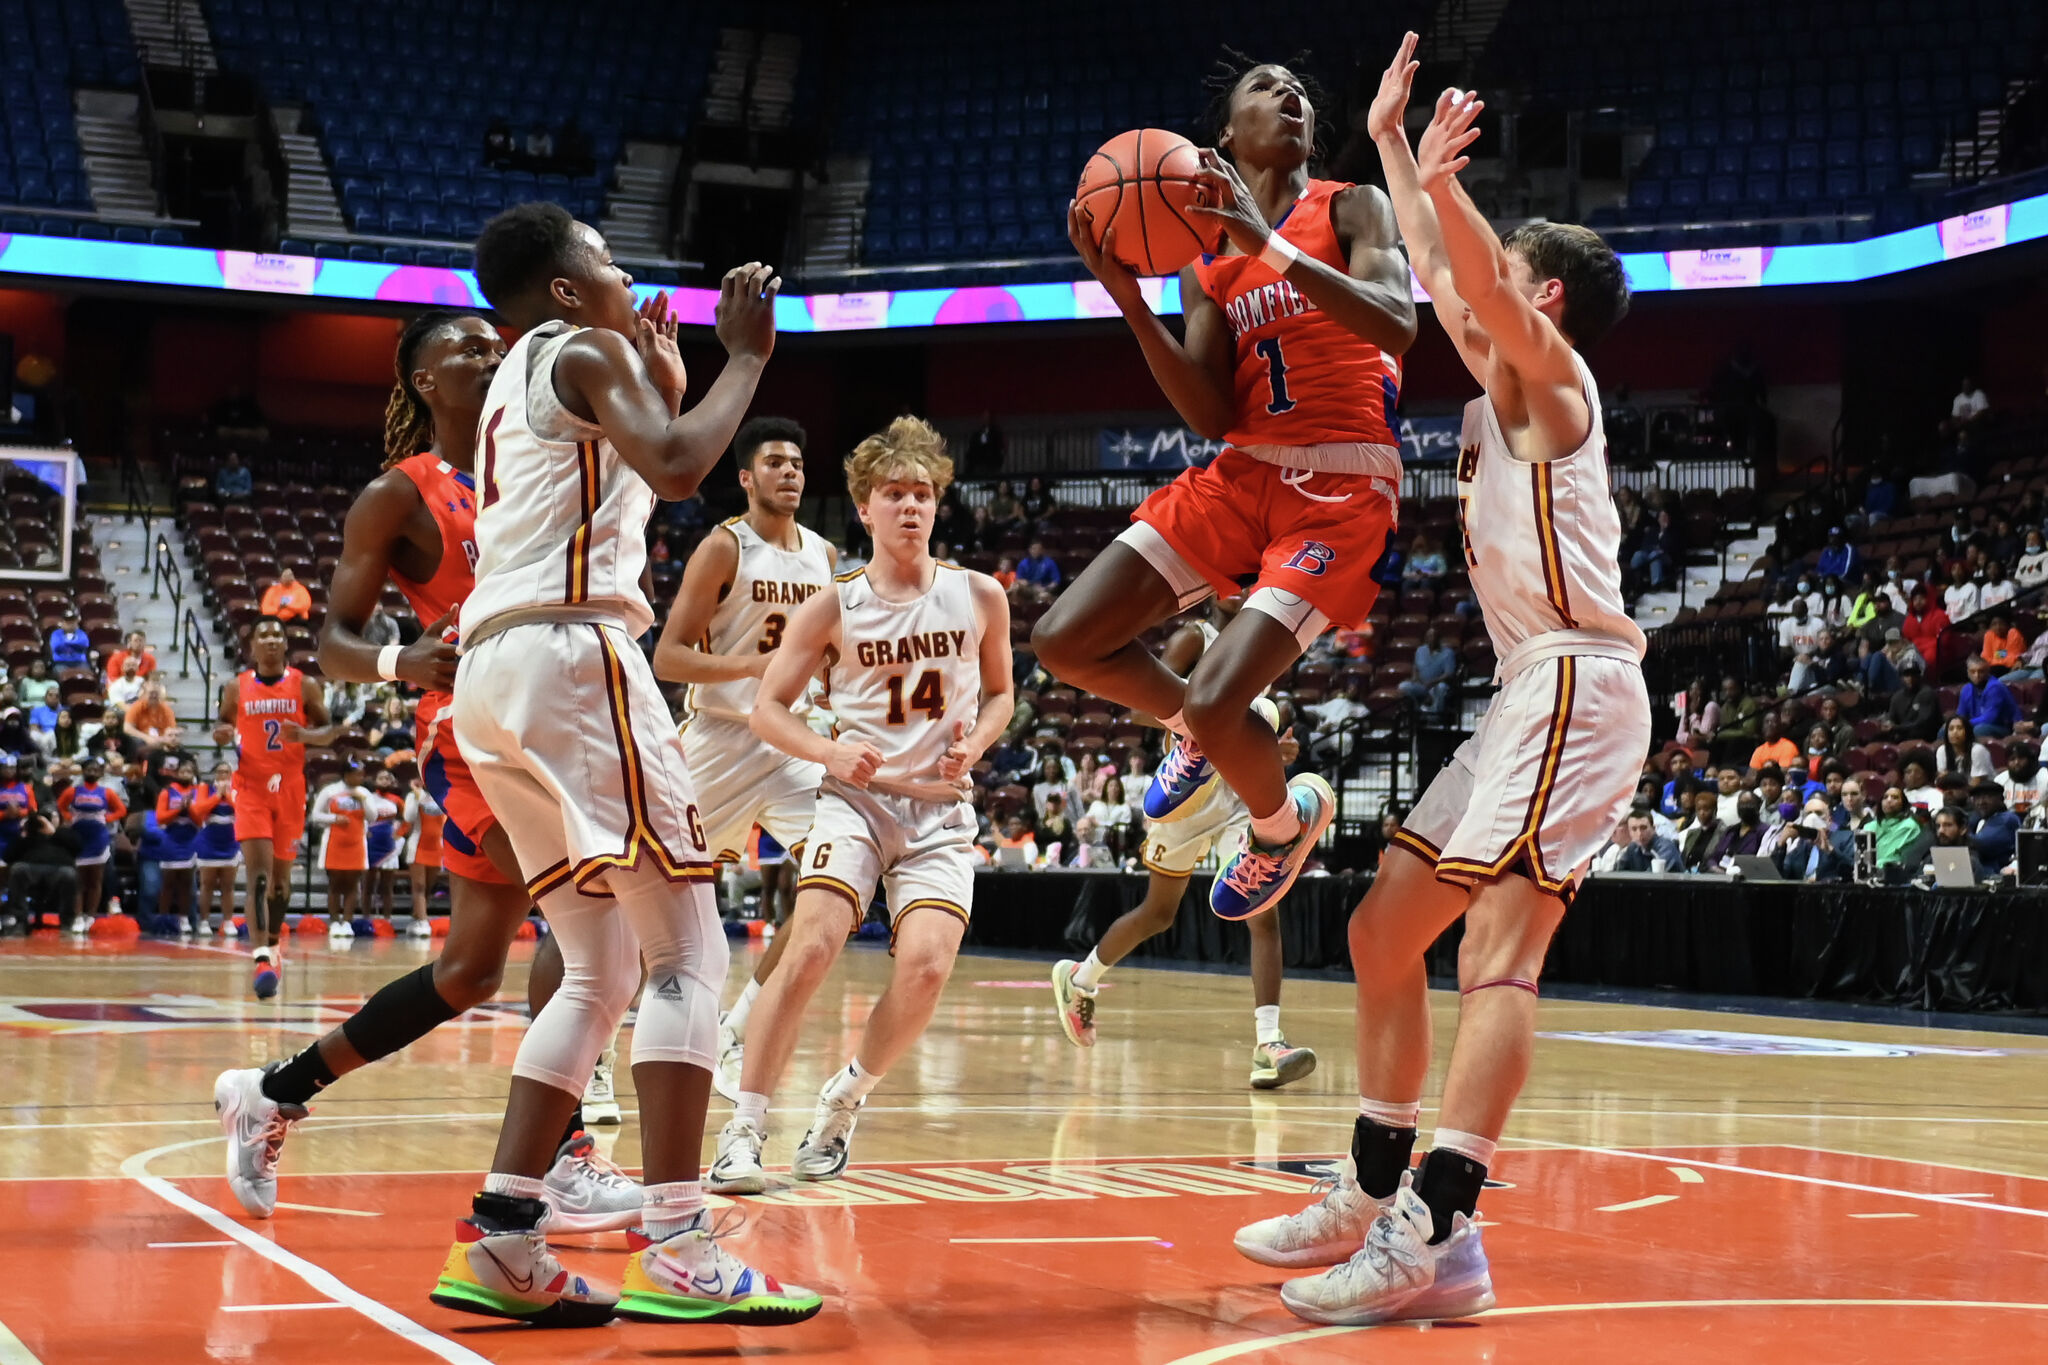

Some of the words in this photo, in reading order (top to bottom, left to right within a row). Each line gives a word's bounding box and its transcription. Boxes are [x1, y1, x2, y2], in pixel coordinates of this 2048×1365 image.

[1255, 336, 1298, 415] 1
[1281, 540, 1336, 577] B
[857, 630, 967, 668] GRANBY
[886, 668, 947, 726] 14
[264, 719, 284, 751] 2
[686, 804, 707, 852] G
[812, 842, 833, 869] G
